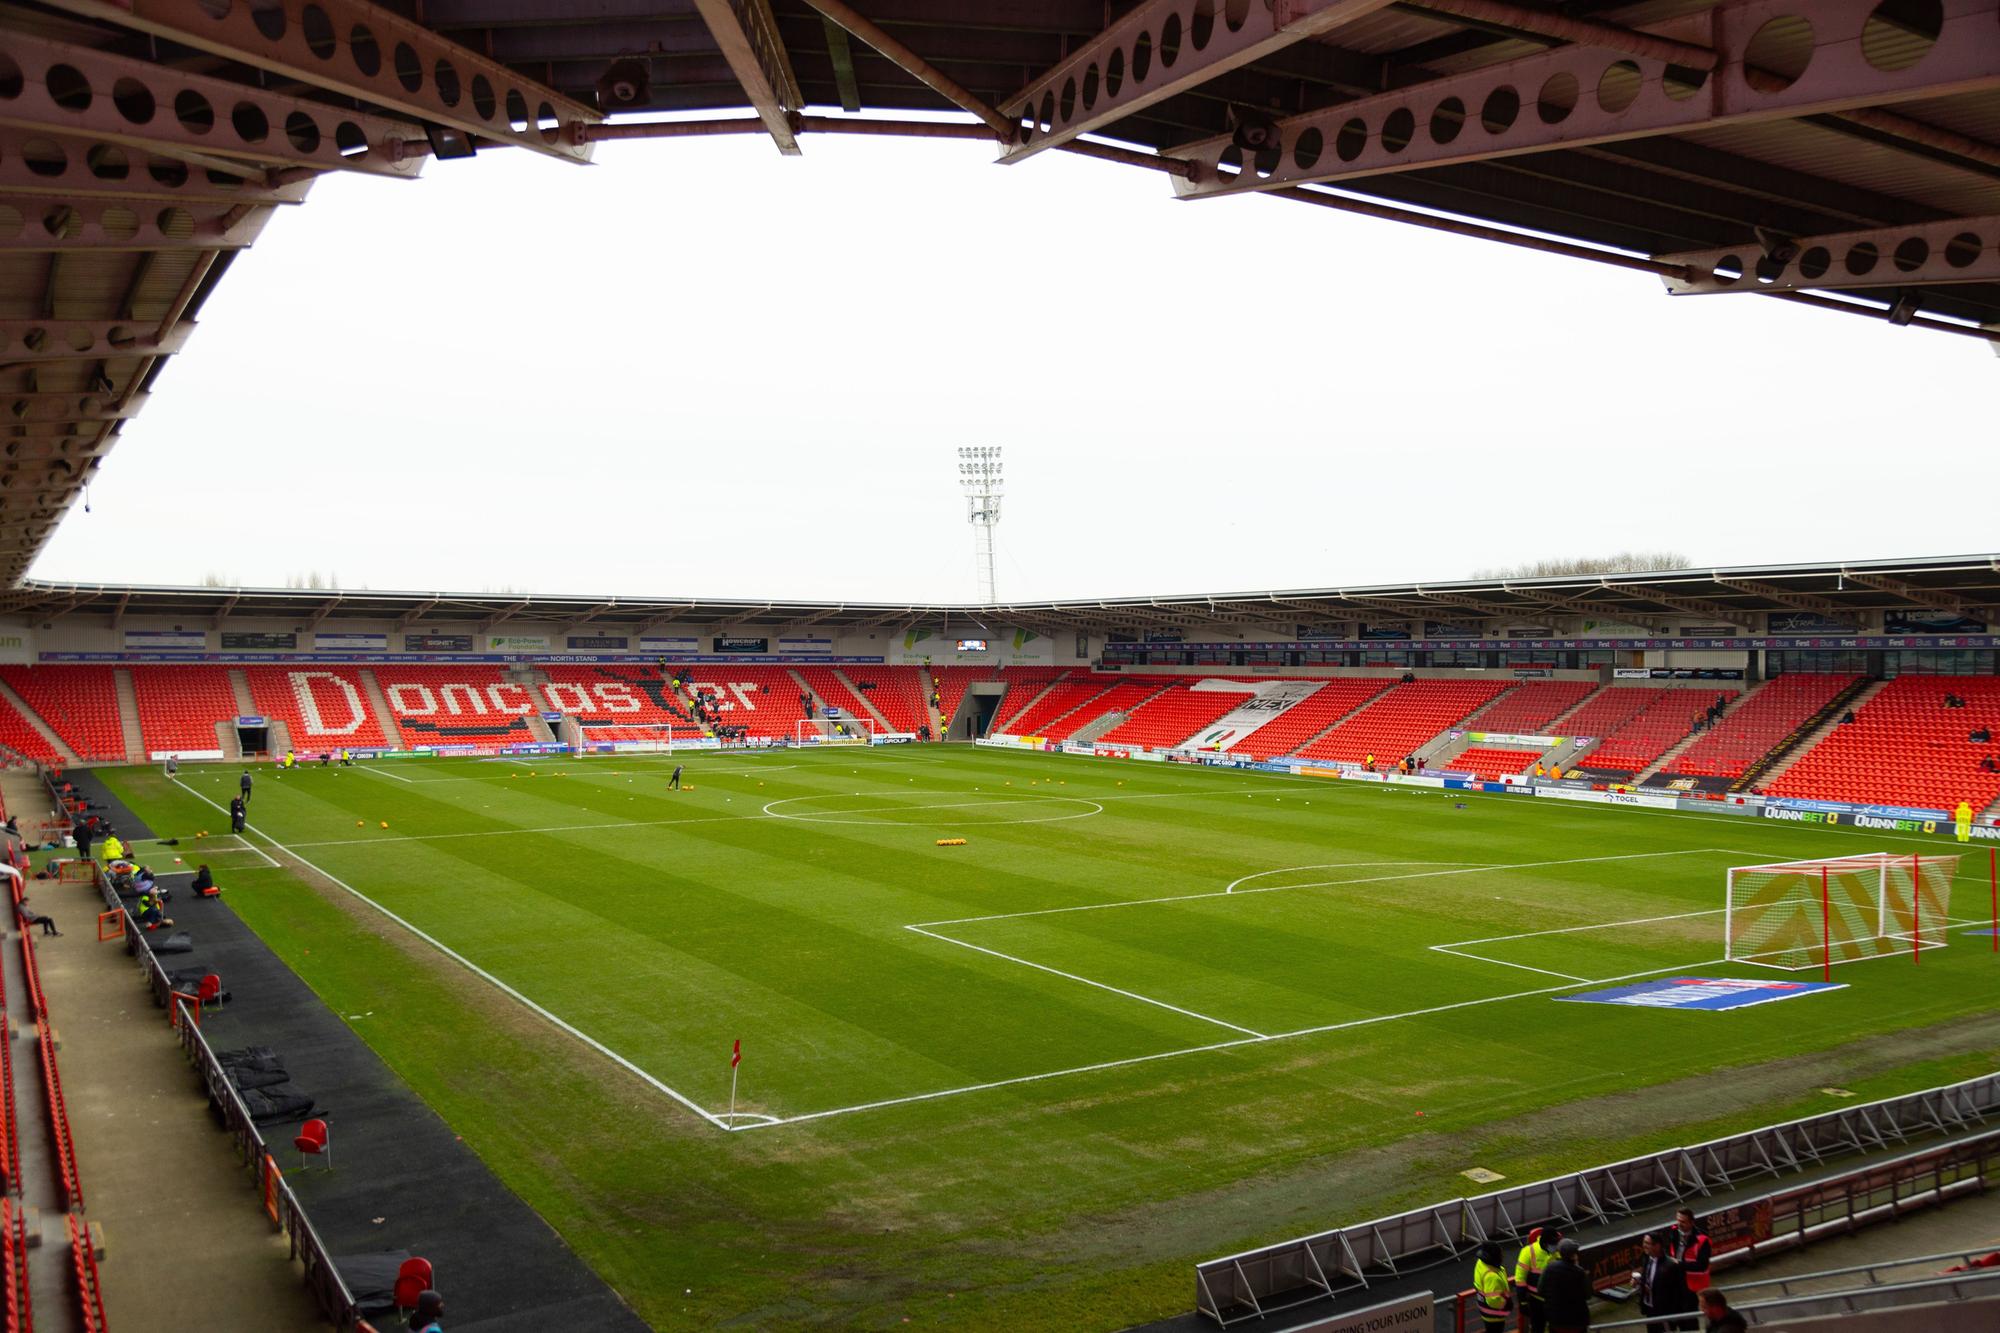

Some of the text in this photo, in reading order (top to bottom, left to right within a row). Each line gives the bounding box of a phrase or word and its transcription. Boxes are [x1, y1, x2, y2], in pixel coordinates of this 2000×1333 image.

[1462, 781, 1472, 790] sky
[1764, 806, 1826, 823] QUINNBET
[1854, 815, 1922, 831] QUINNBET
[1366, 1315, 1394, 1332] YOUR
[1394, 1305, 1428, 1325] VISION
